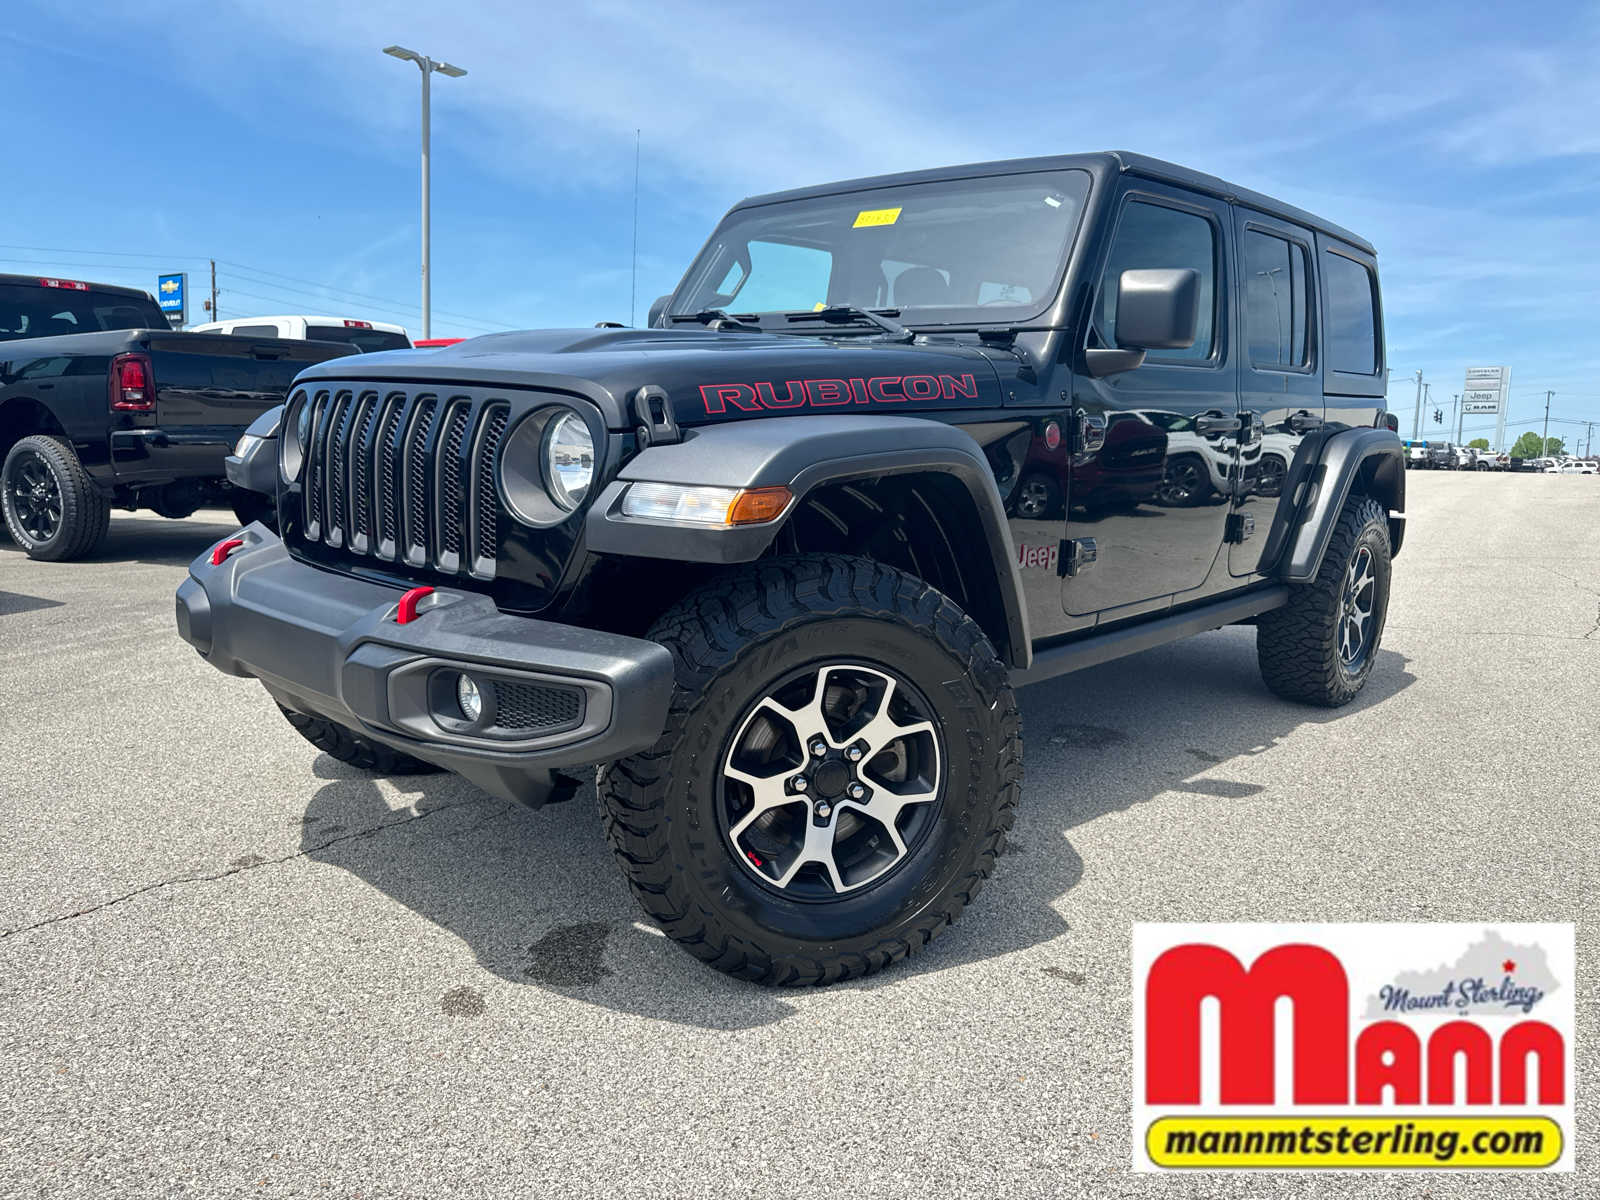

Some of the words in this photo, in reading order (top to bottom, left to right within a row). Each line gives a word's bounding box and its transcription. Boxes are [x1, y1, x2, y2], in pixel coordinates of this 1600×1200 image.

[699, 374, 978, 414] RUBICON
[1470, 392, 1492, 400] Jeep
[1018, 543, 1057, 569] Jeep
